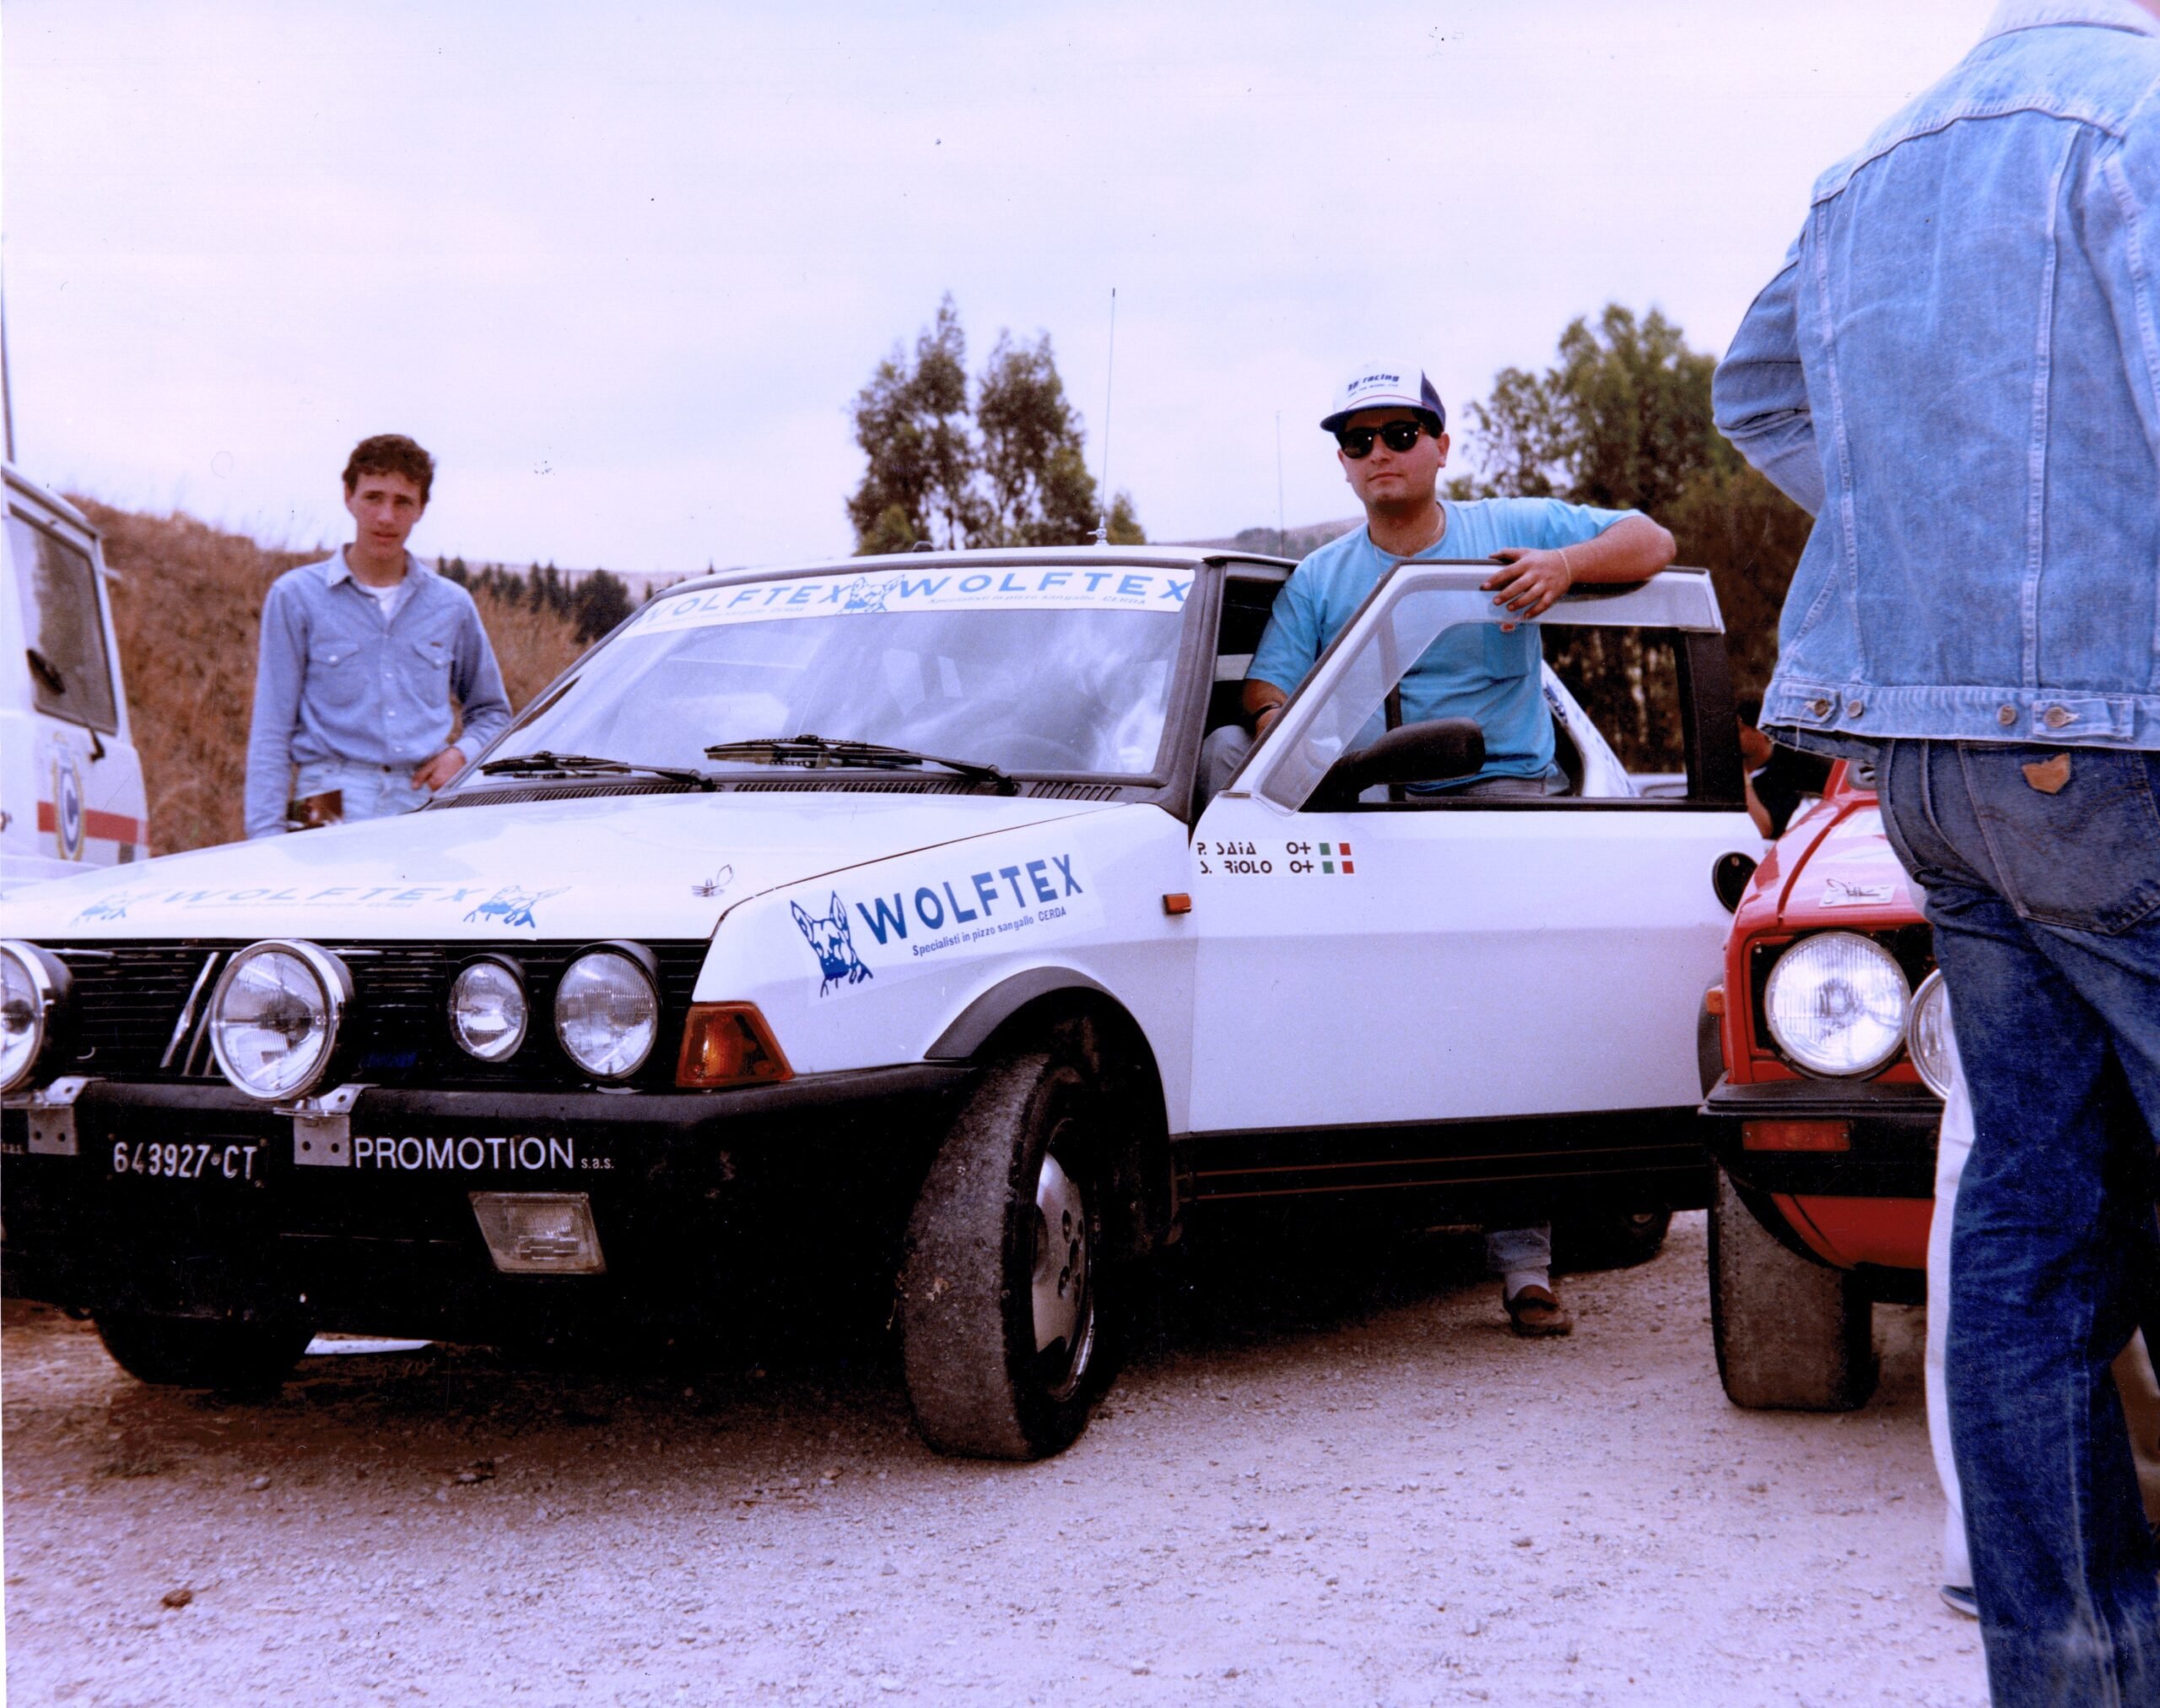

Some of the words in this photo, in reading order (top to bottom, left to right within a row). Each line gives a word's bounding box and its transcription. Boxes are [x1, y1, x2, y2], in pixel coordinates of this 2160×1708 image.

[899, 571, 1192, 602] WOLFTEX
[1196, 841, 1207, 856] P.
[1200, 860, 1212, 874] S.
[162, 886, 487, 903] WOLFTEX
[856, 853, 1083, 945] WOLFTEX
[912, 933, 960, 957] Specialisti
[962, 932, 971, 943] in
[972, 927, 996, 943] pizzo
[1038, 906, 1066, 922] CERDA
[354, 1137, 574, 1170] PROMOTION
[580, 1157, 615, 1170] s.a.s.
